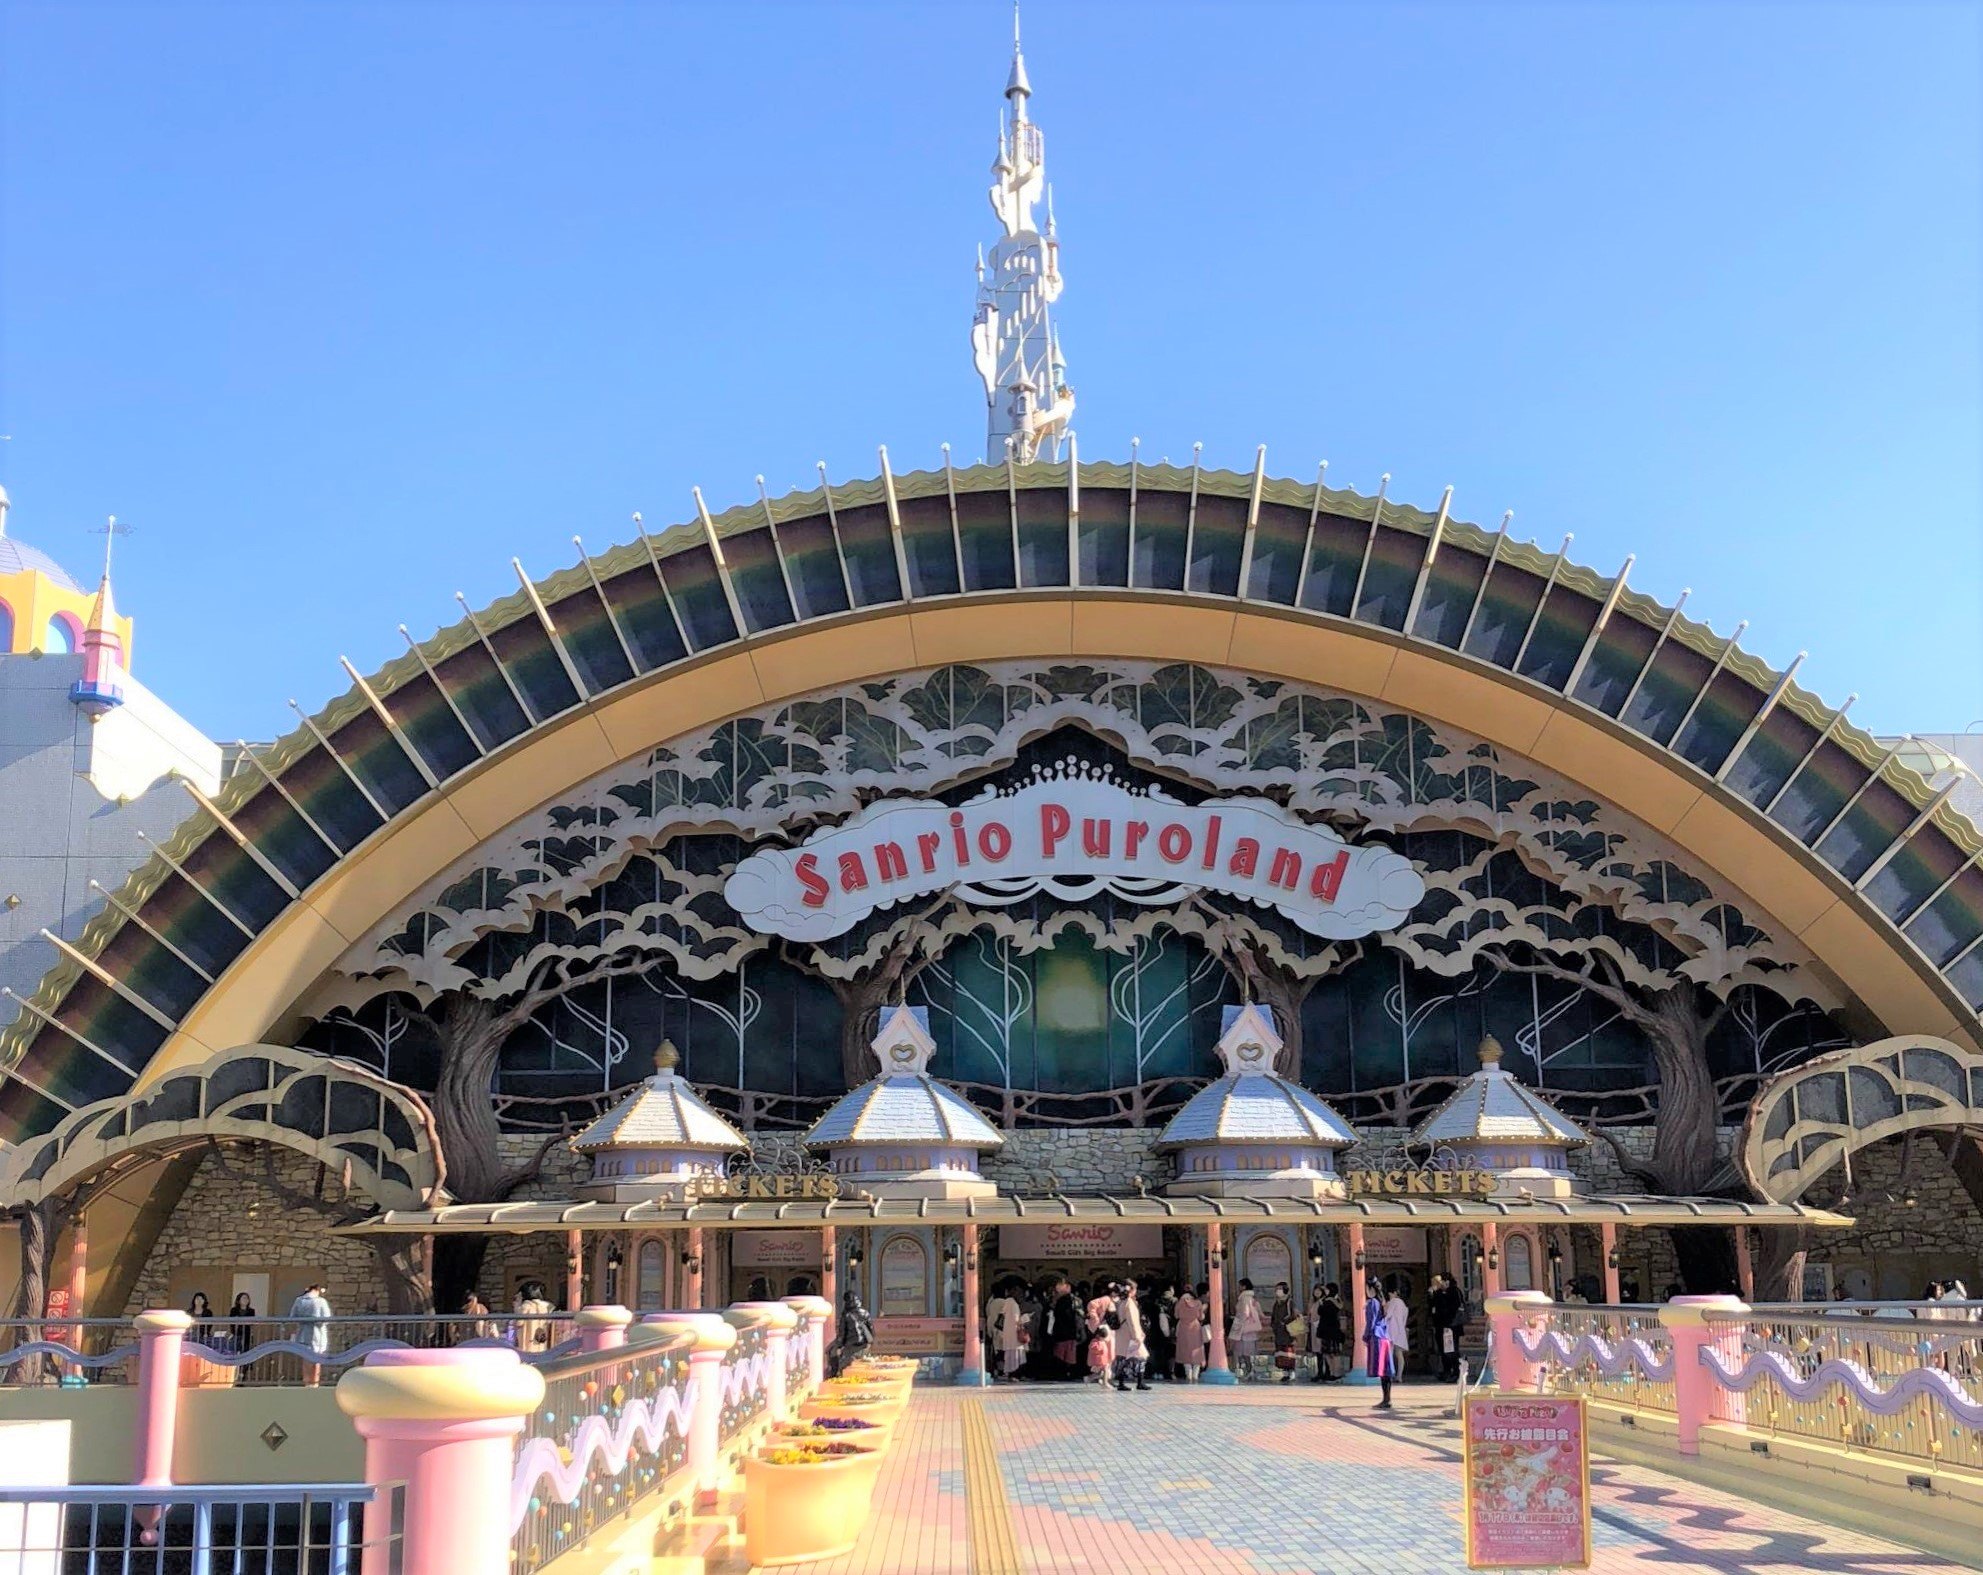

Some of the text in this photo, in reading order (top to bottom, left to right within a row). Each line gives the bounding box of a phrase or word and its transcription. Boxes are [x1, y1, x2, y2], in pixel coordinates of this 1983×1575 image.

[794, 803, 1351, 908] Sanrio Puroland
[684, 1174, 838, 1197] TICKETS
[1347, 1171, 1500, 1193] TICKETS
[1047, 1225, 1114, 1241] Sanrio
